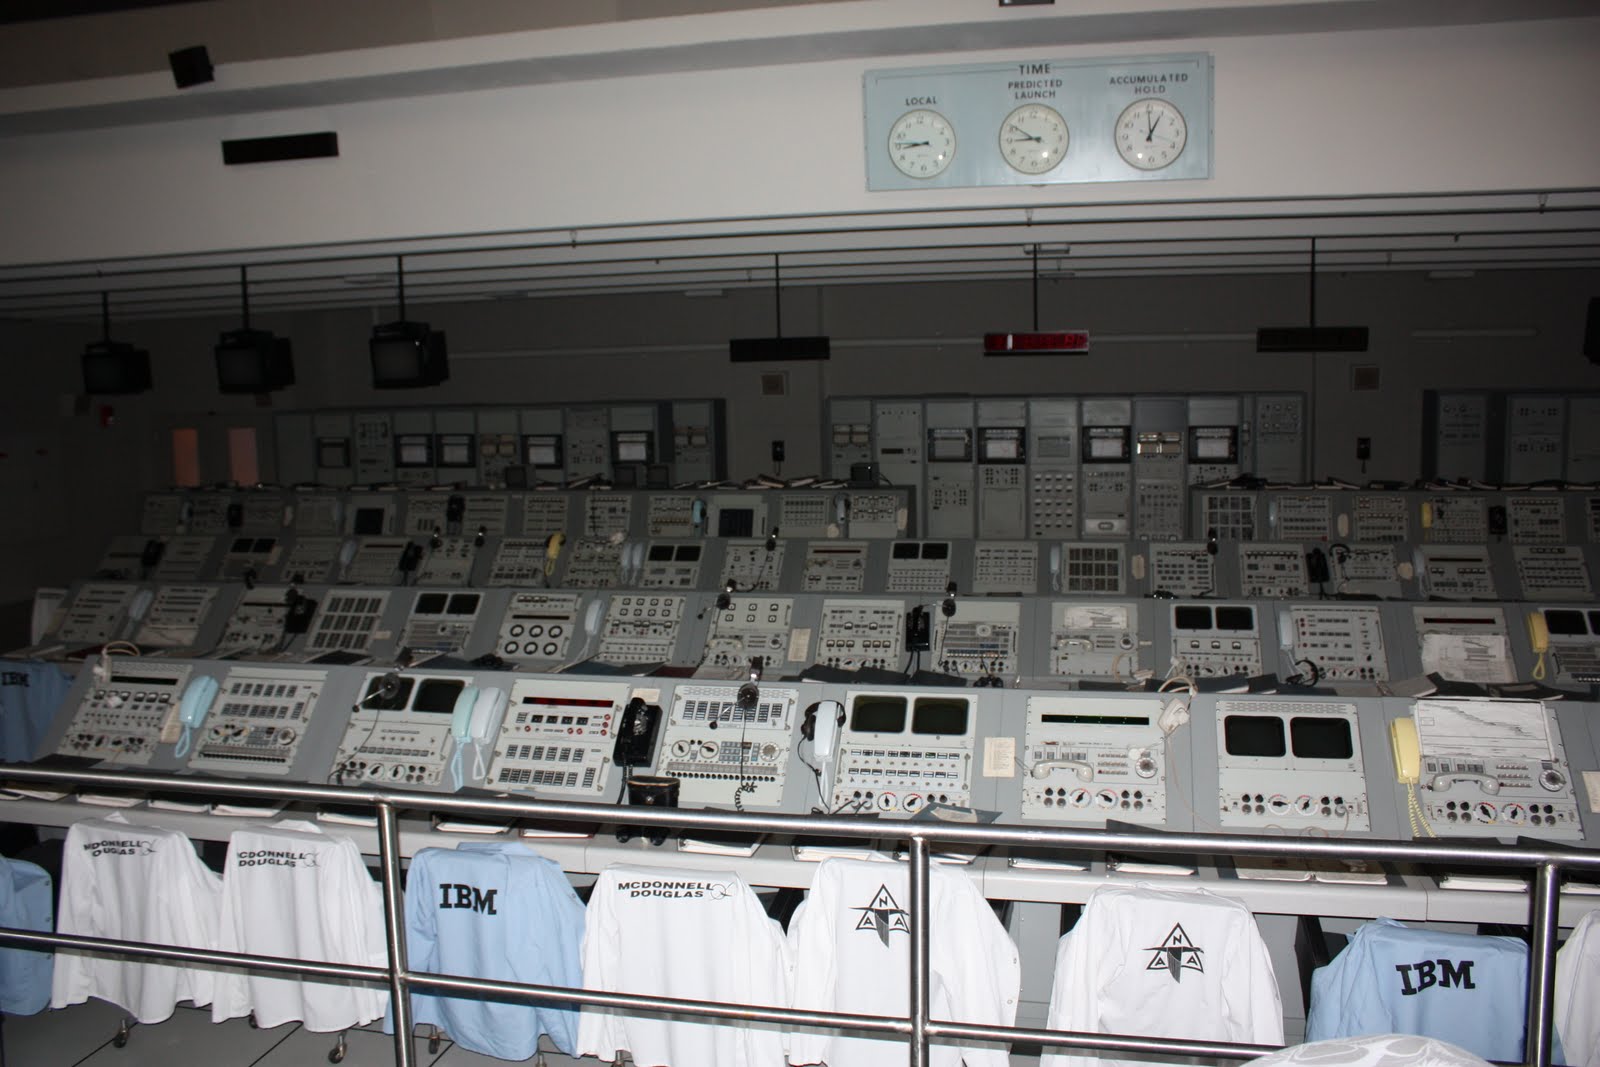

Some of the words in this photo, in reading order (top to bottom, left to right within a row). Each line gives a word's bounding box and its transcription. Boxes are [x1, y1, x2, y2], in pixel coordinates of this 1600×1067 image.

[1019, 63, 1051, 76] TIME
[1008, 79, 1063, 89] PREDICTED
[1109, 73, 1188, 85] ACCUMULATED
[1015, 90, 1056, 100] LAUNCH
[1134, 85, 1166, 95] HOLD
[904, 97, 937, 106] LOCAL
[2, 671, 30, 687] IBM
[83, 840, 142, 851] MDONNELL
[236, 850, 305, 860] CDONNELL
[238, 858, 296, 868] DOUGLAS
[618, 881, 713, 891] MCDONNELL
[439, 883, 498, 916] IBM
[630, 889, 704, 899] DOUGLAS
[879, 895, 888, 908] N
[863, 915, 874, 927] A
[893, 916, 905, 928] A
[1173, 934, 1182, 946] N
[1154, 956, 1165, 967] A
[1187, 955, 1198, 967] A
[1395, 958, 1476, 996] IBM
